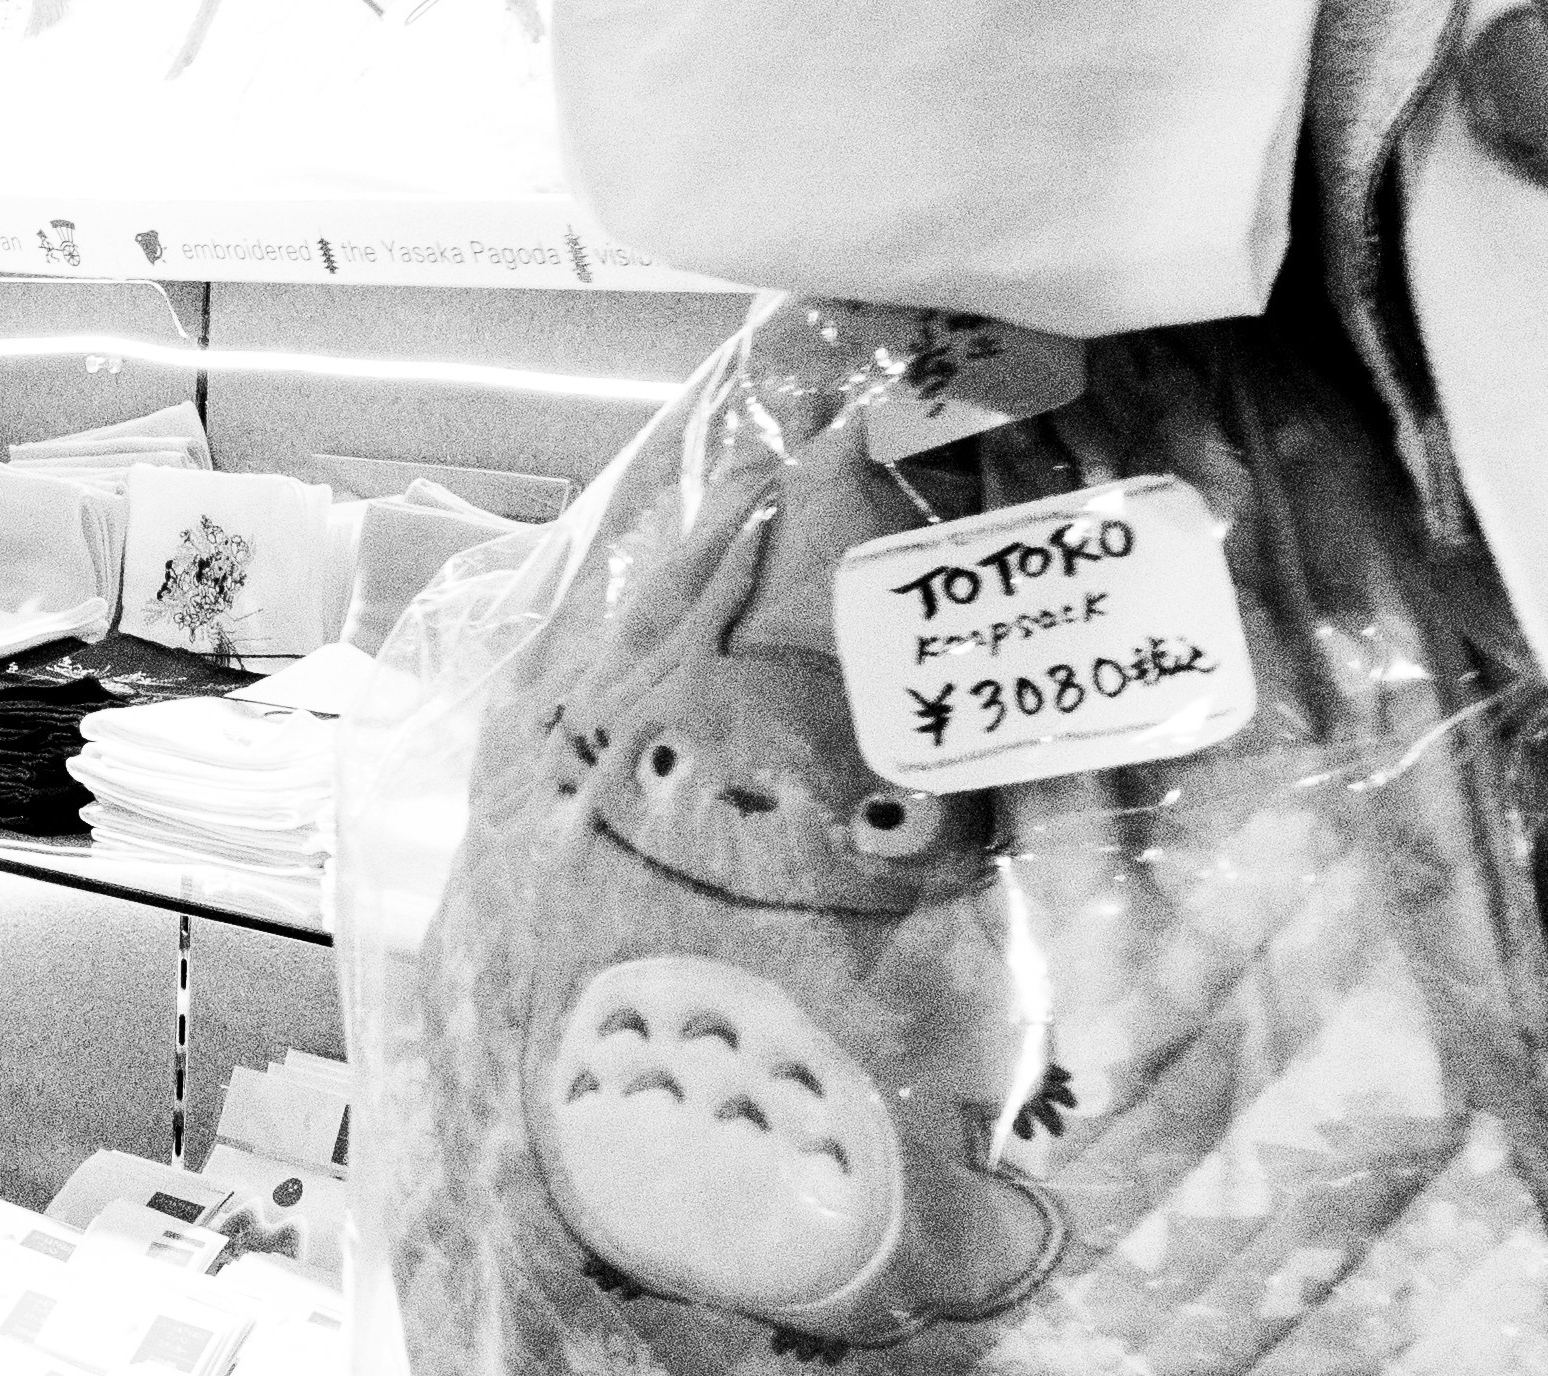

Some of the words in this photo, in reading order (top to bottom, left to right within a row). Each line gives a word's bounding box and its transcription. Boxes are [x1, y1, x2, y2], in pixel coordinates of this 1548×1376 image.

[181, 234, 314, 264] embroidered
[342, 238, 377, 265] the
[382, 239, 465, 266] Yasaka
[469, 240, 562, 272] Pagoda
[891, 518, 1136, 620] TOTORO
